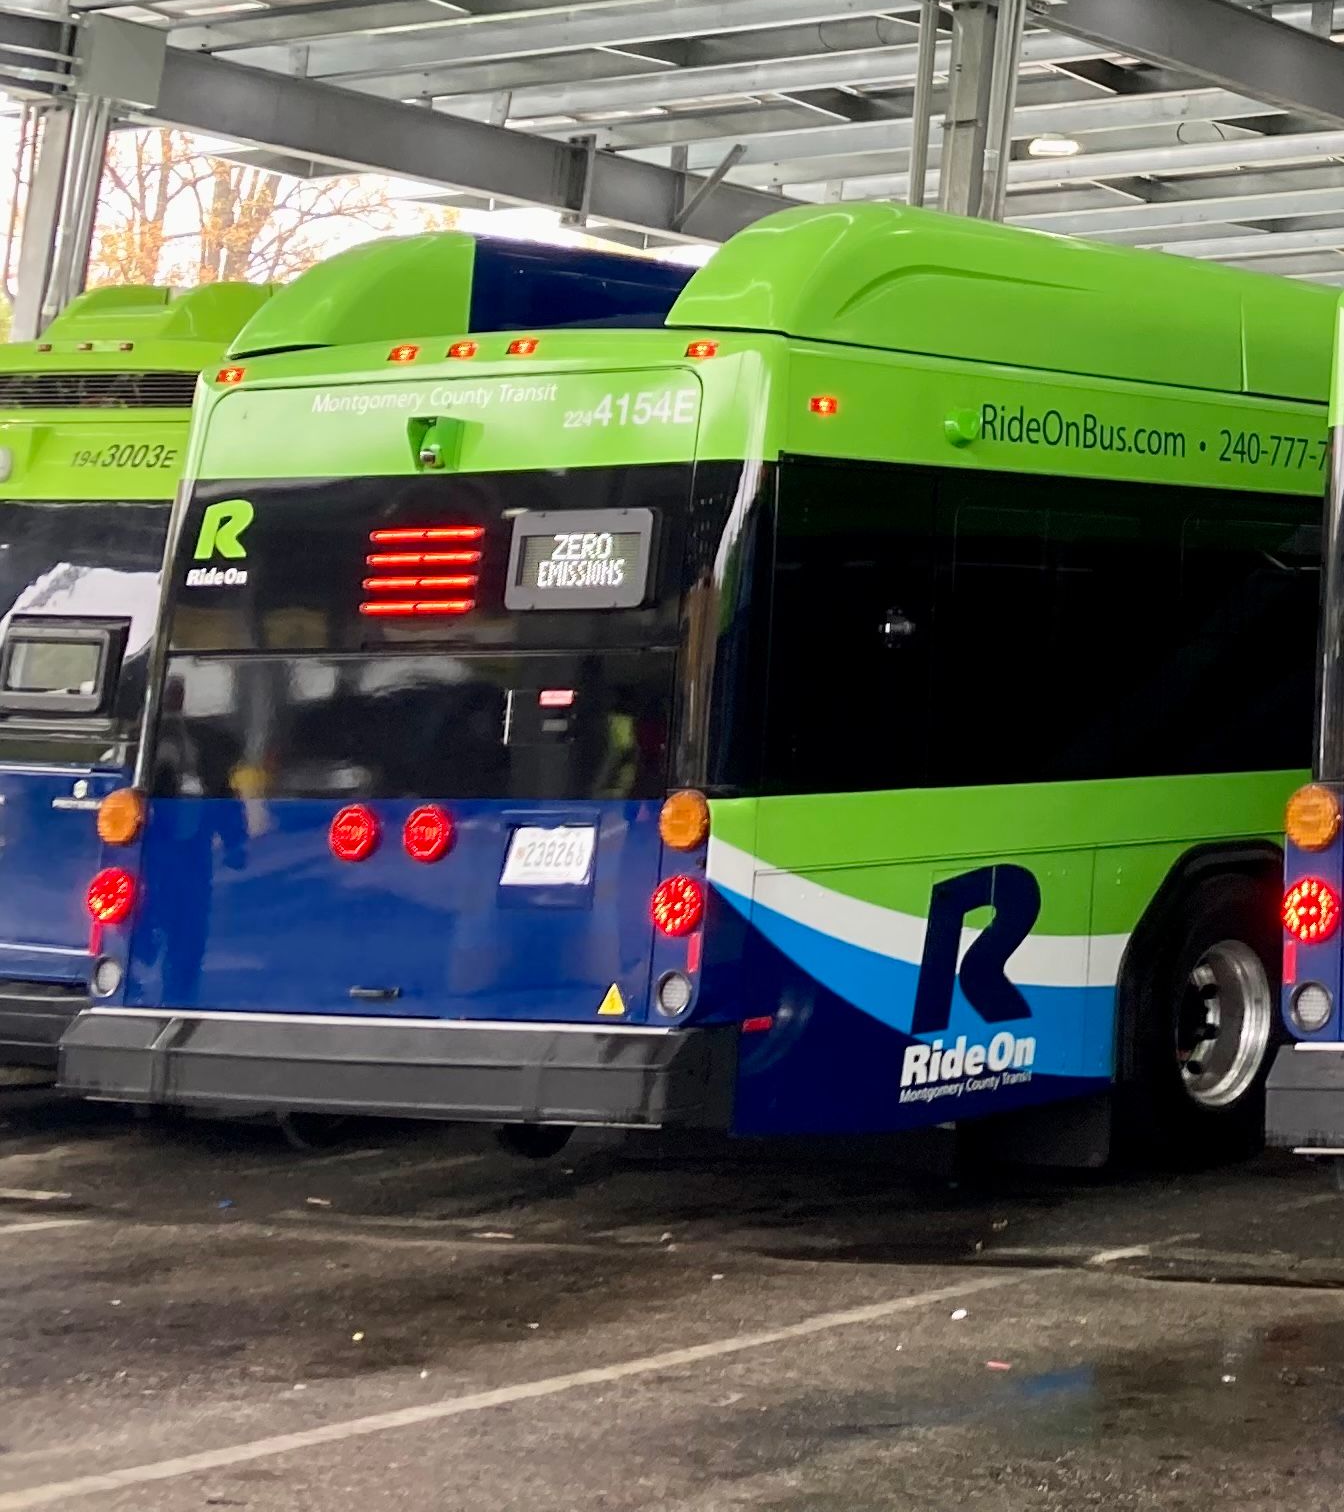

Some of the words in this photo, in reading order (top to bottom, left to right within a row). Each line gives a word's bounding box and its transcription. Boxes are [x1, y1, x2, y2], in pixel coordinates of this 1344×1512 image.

[312, 390, 424, 416] Montgomery
[430, 386, 493, 409] County
[499, 383, 559, 404] Transit
[981, 403, 1187, 458] RideOnBus.com
[552, 533, 613, 560] ZERO
[186, 567, 248, 586] RideOn
[537, 558, 625, 587] EMISSIONS
[410, 826, 438, 841] STOP
[523, 841, 575, 868] 23826
[900, 1031, 1036, 1088] RideOn
[899, 1082, 965, 1104] Montgomery
[966, 1075, 1001, 1093] County
[1002, 1069, 1033, 1086] Transit
